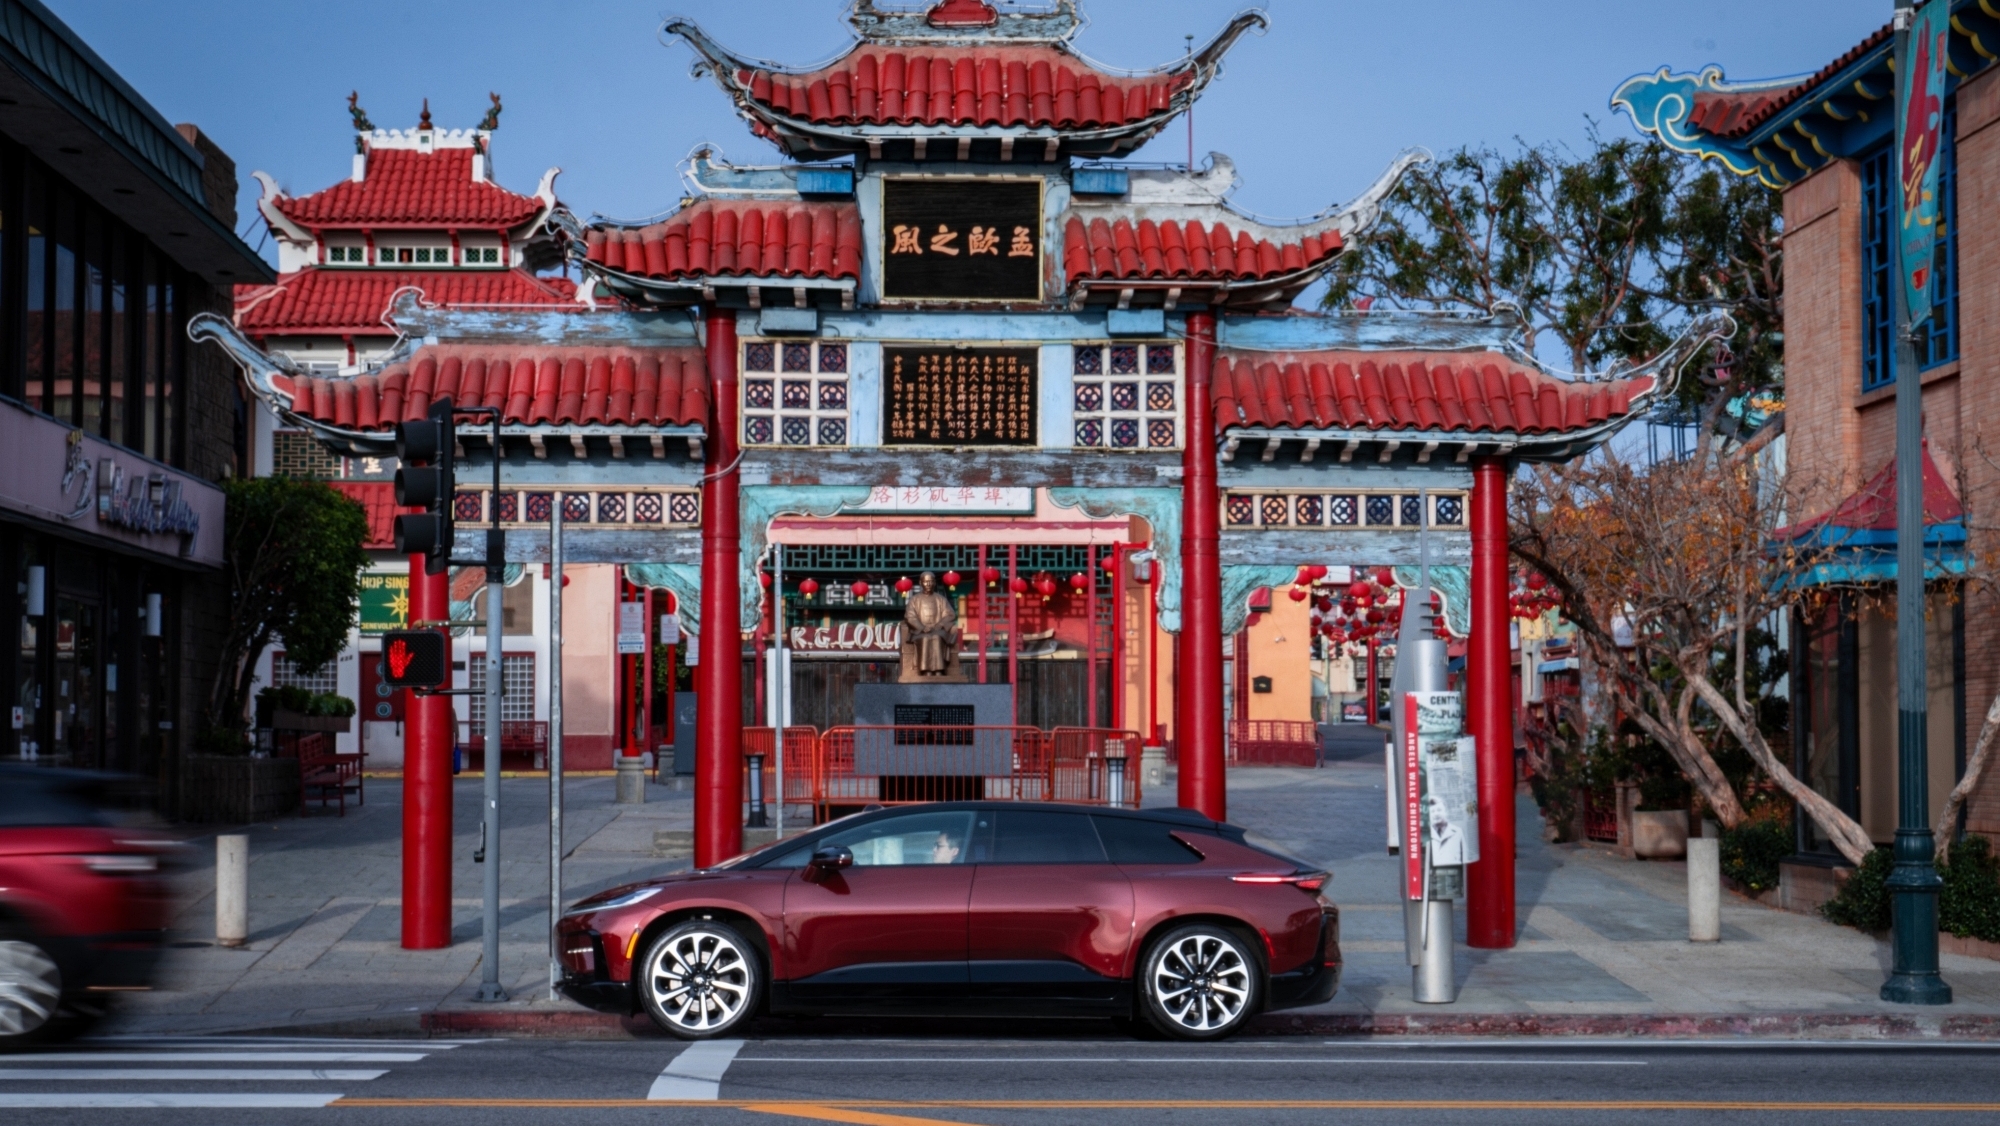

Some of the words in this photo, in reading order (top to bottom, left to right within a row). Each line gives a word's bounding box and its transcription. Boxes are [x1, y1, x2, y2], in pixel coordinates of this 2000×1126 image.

[873, 486, 1004, 506] 洛杉矶华埠
[361, 576, 383, 589] HOP
[385, 576, 410, 589] SING
[1408, 732, 1416, 768] ANGELS
[1408, 771, 1417, 799] WALK
[1408, 802, 1418, 859] CHINATOWN
